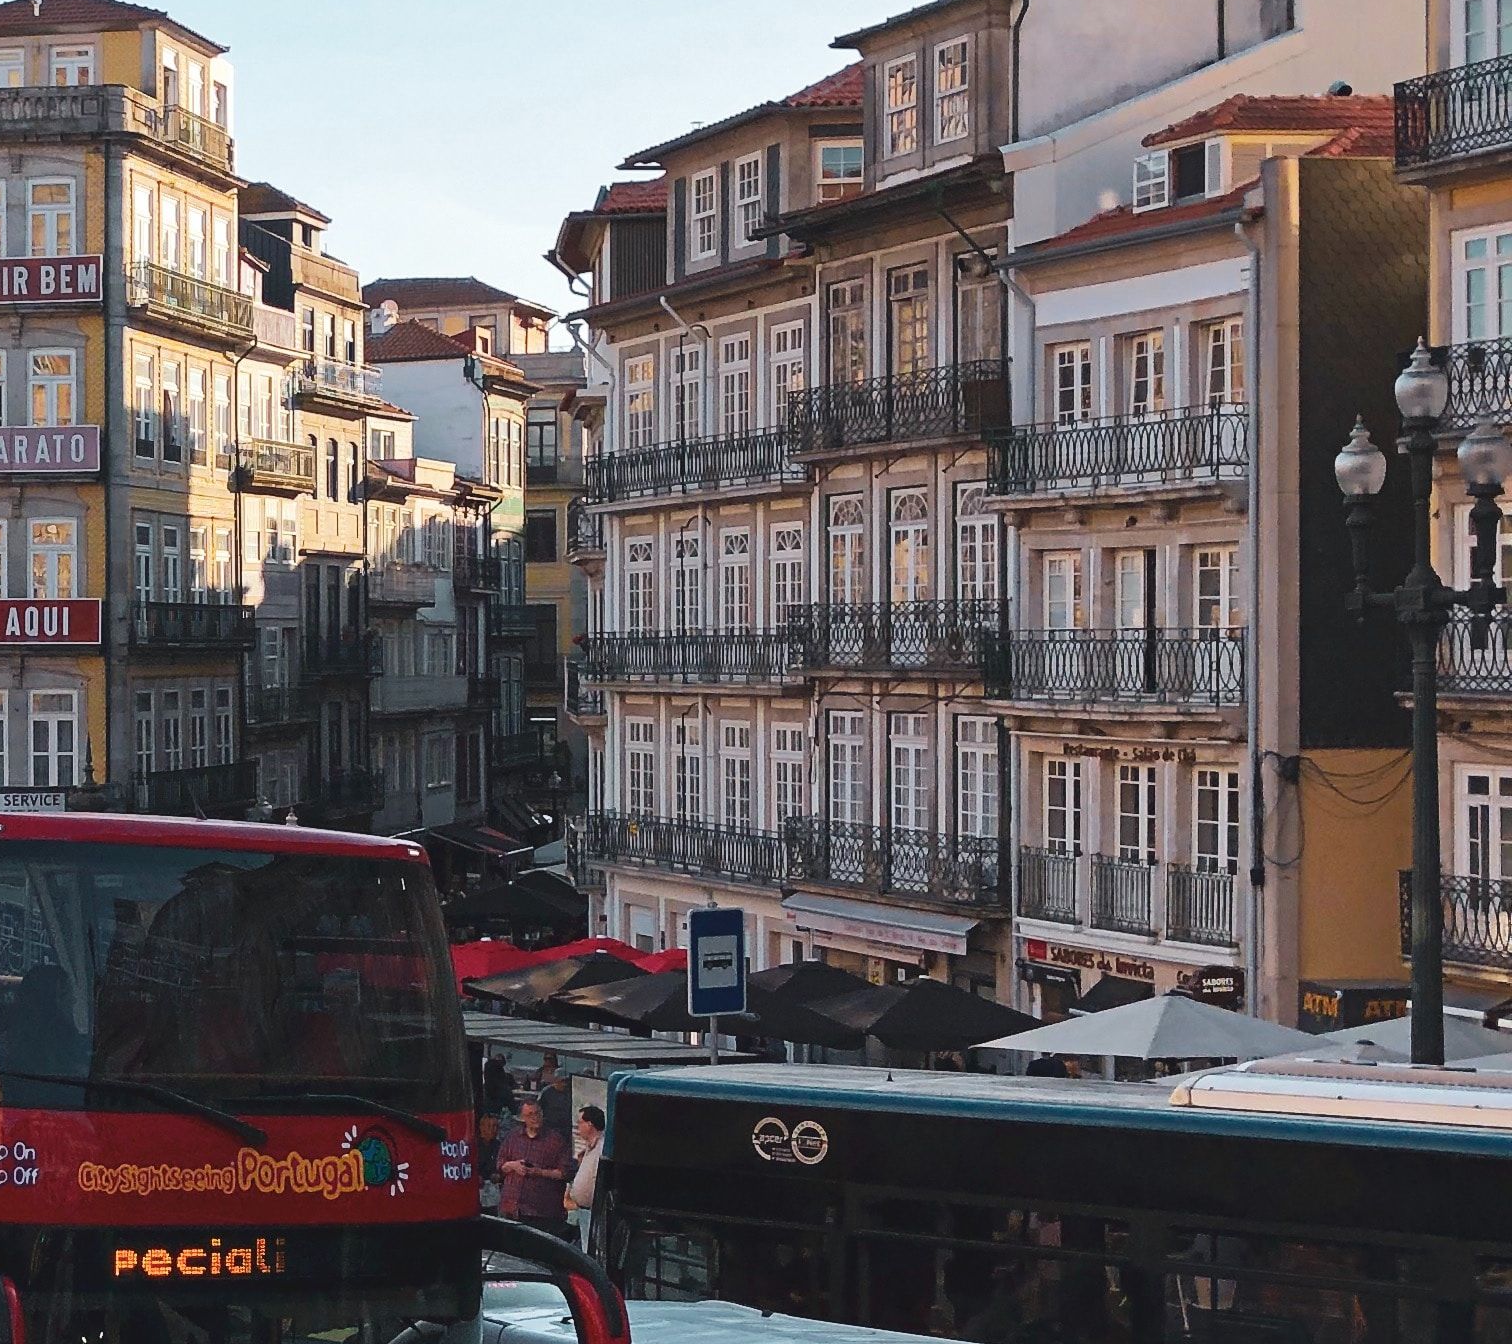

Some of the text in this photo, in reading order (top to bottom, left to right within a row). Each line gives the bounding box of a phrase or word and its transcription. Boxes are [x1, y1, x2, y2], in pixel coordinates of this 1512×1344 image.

[40, 263, 96, 294] BEM
[5, 606, 69, 637] AQUI
[4, 794, 60, 807] SERVICE
[1050, 946, 1095, 970] SABORES
[1303, 992, 1340, 1018] ATM
[13, 1141, 36, 1161] On
[440, 1141, 458, 1158] Hop
[13, 1167, 39, 1185] Off
[78, 1147, 365, 1200] CitySightseeing Portugal
[443, 1163, 460, 1181] Hop
